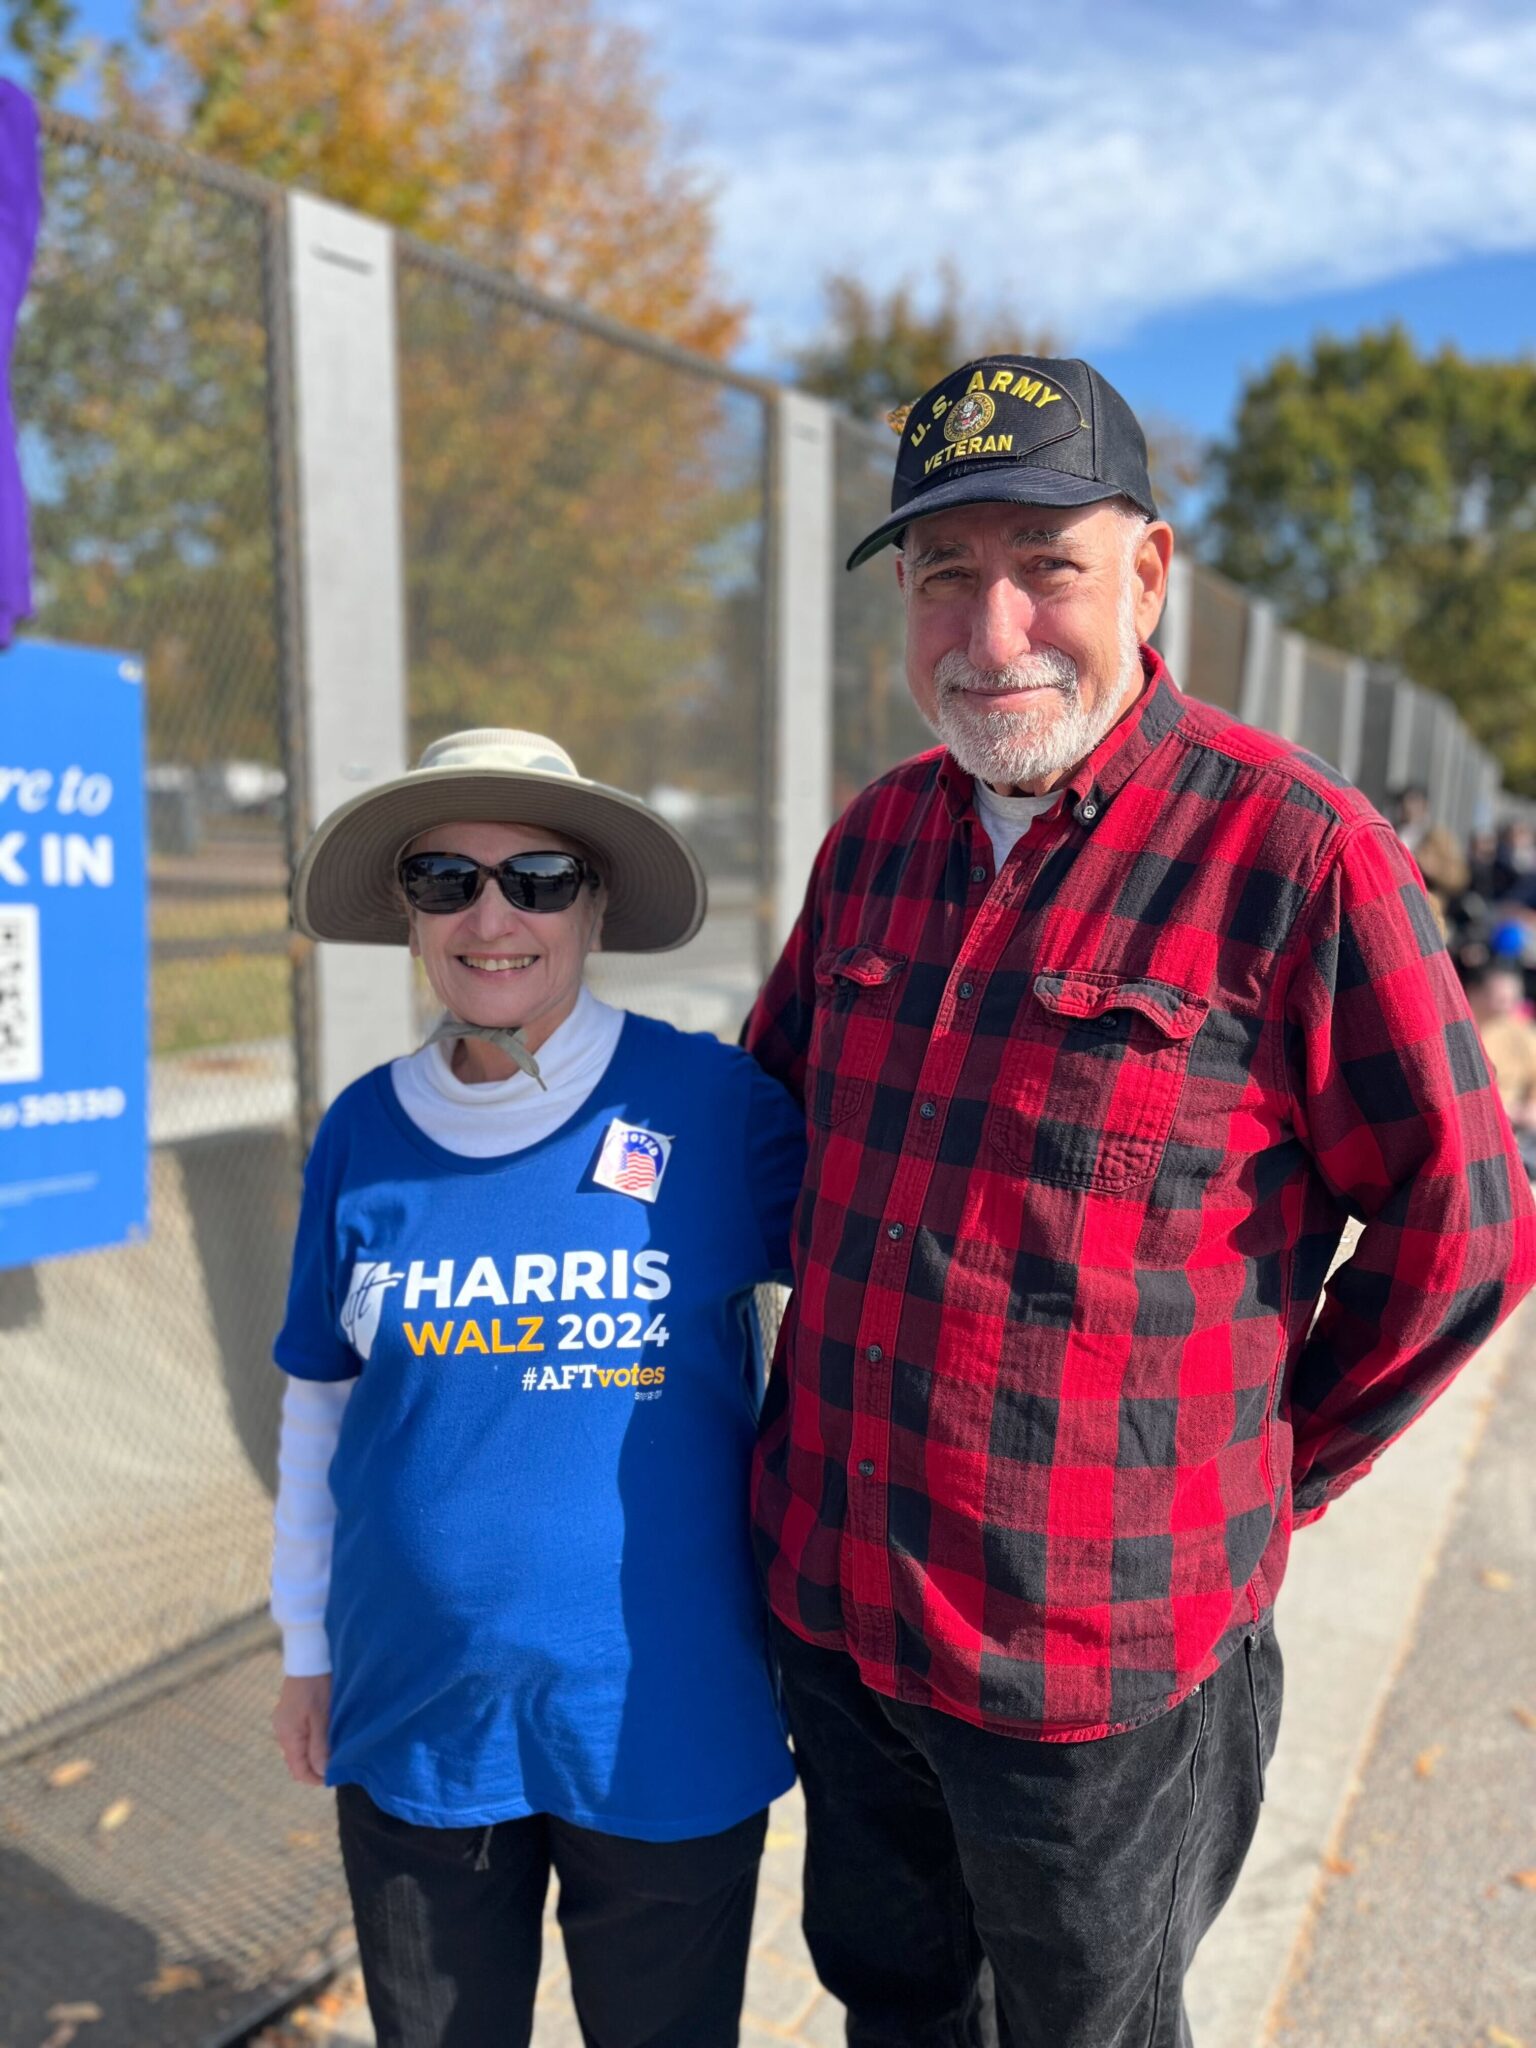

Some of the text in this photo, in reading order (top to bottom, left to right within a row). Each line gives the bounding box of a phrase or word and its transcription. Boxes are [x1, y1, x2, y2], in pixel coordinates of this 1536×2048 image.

[966, 370, 1061, 408] ARMY
[924, 435, 1013, 475] VETERAN
[56, 764, 113, 817] to
[41, 832, 114, 888] IN
[404, 1249, 672, 1309] HARRIS
[403, 1314, 670, 1356] WALZ 2024
[522, 1363, 665, 1391] #AFTvotes
